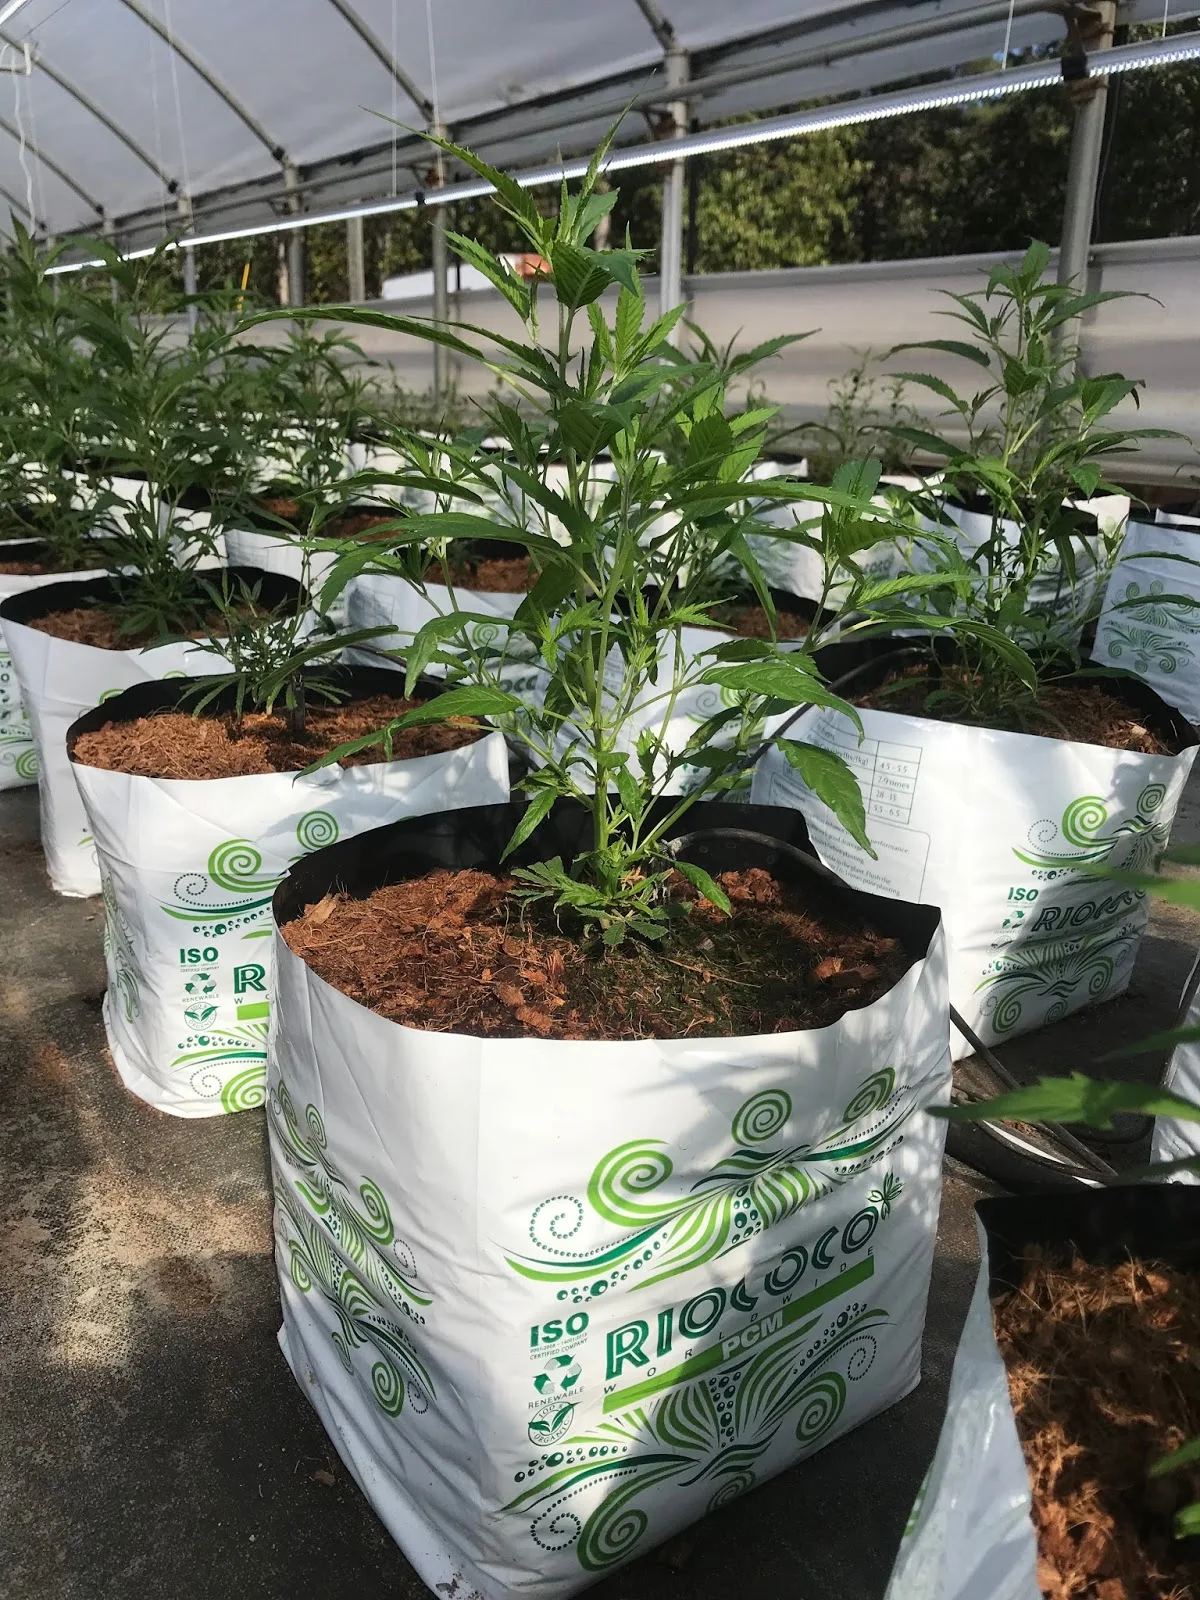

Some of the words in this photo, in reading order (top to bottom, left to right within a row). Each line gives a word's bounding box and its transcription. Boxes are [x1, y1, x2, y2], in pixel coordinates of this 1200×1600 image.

[1007, 887, 1039, 902] ISO
[180, 946, 219, 964] ISO
[605, 1206, 879, 1381] RIOCOCO
[530, 1311, 590, 1348] ISO
[721, 1310, 784, 1361] PCM
[529, 1348, 560, 1361] CERTIFIED
[561, 1338, 588, 1353] COMPANY
[528, 1386, 585, 1410] RENEWABLE
